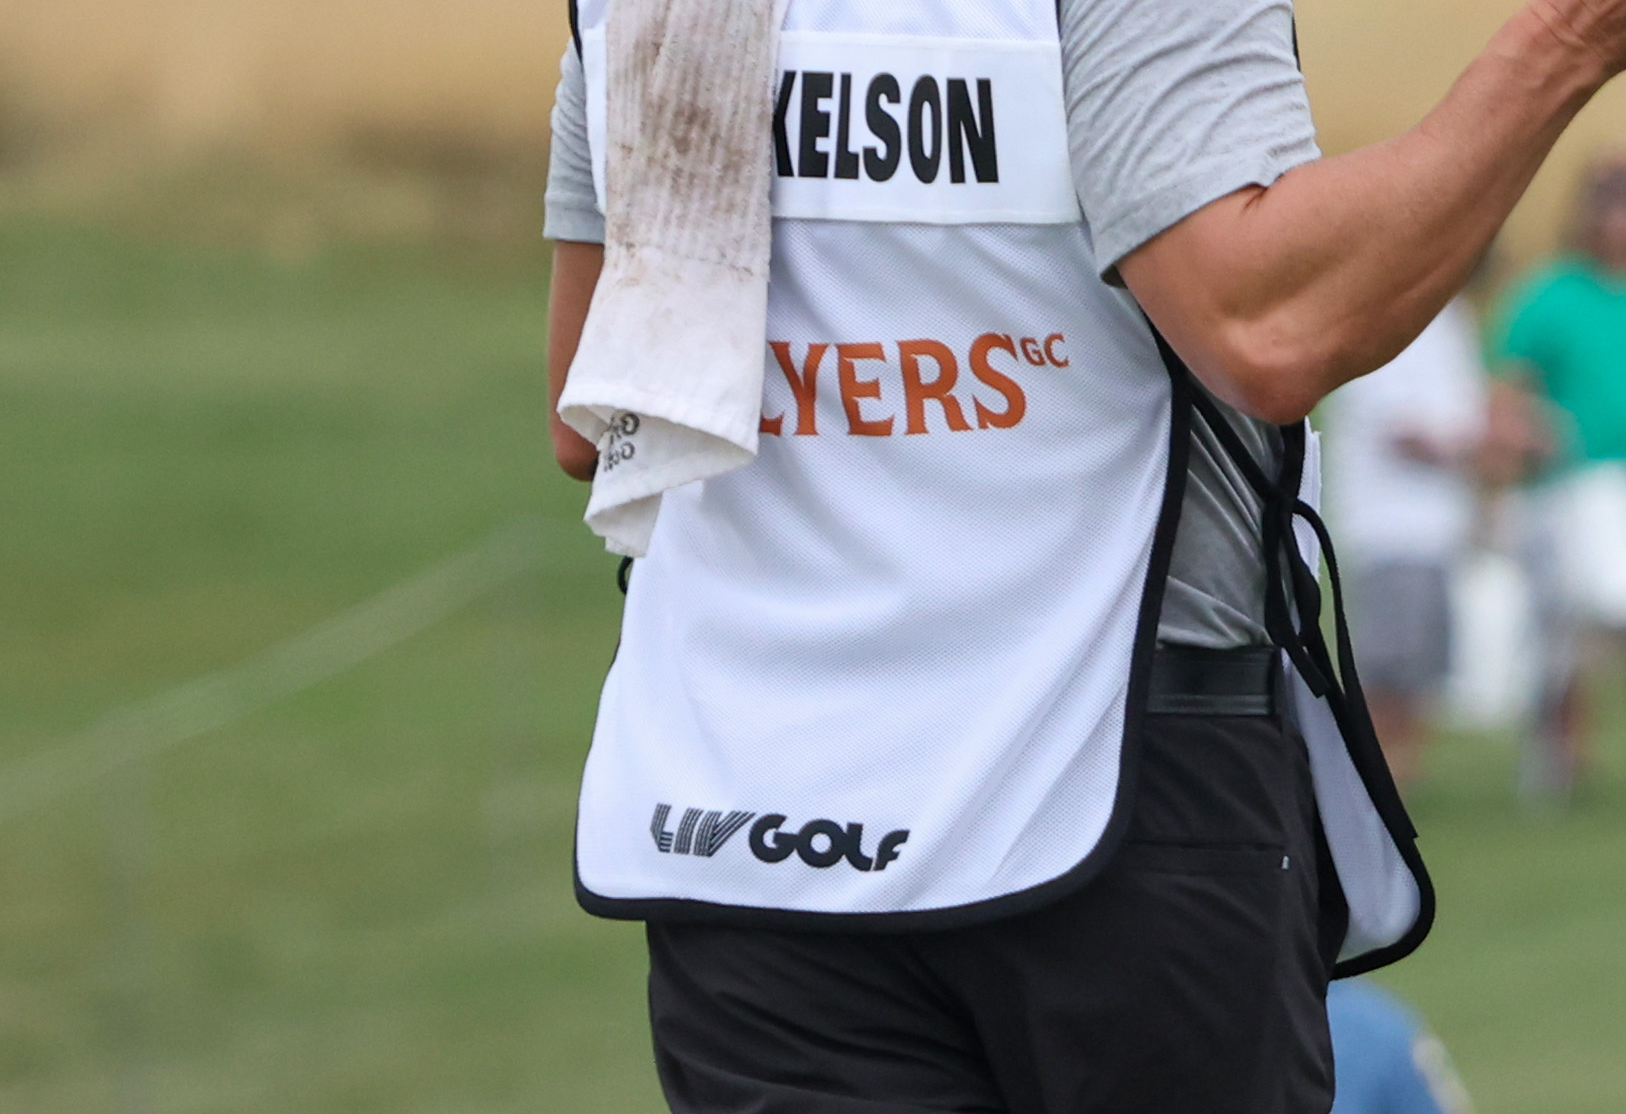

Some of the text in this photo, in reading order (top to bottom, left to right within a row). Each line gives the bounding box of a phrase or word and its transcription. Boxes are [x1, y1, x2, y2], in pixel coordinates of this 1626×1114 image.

[759, 331, 1027, 437] YERS
[650, 802, 911, 873] LIV GOLF
